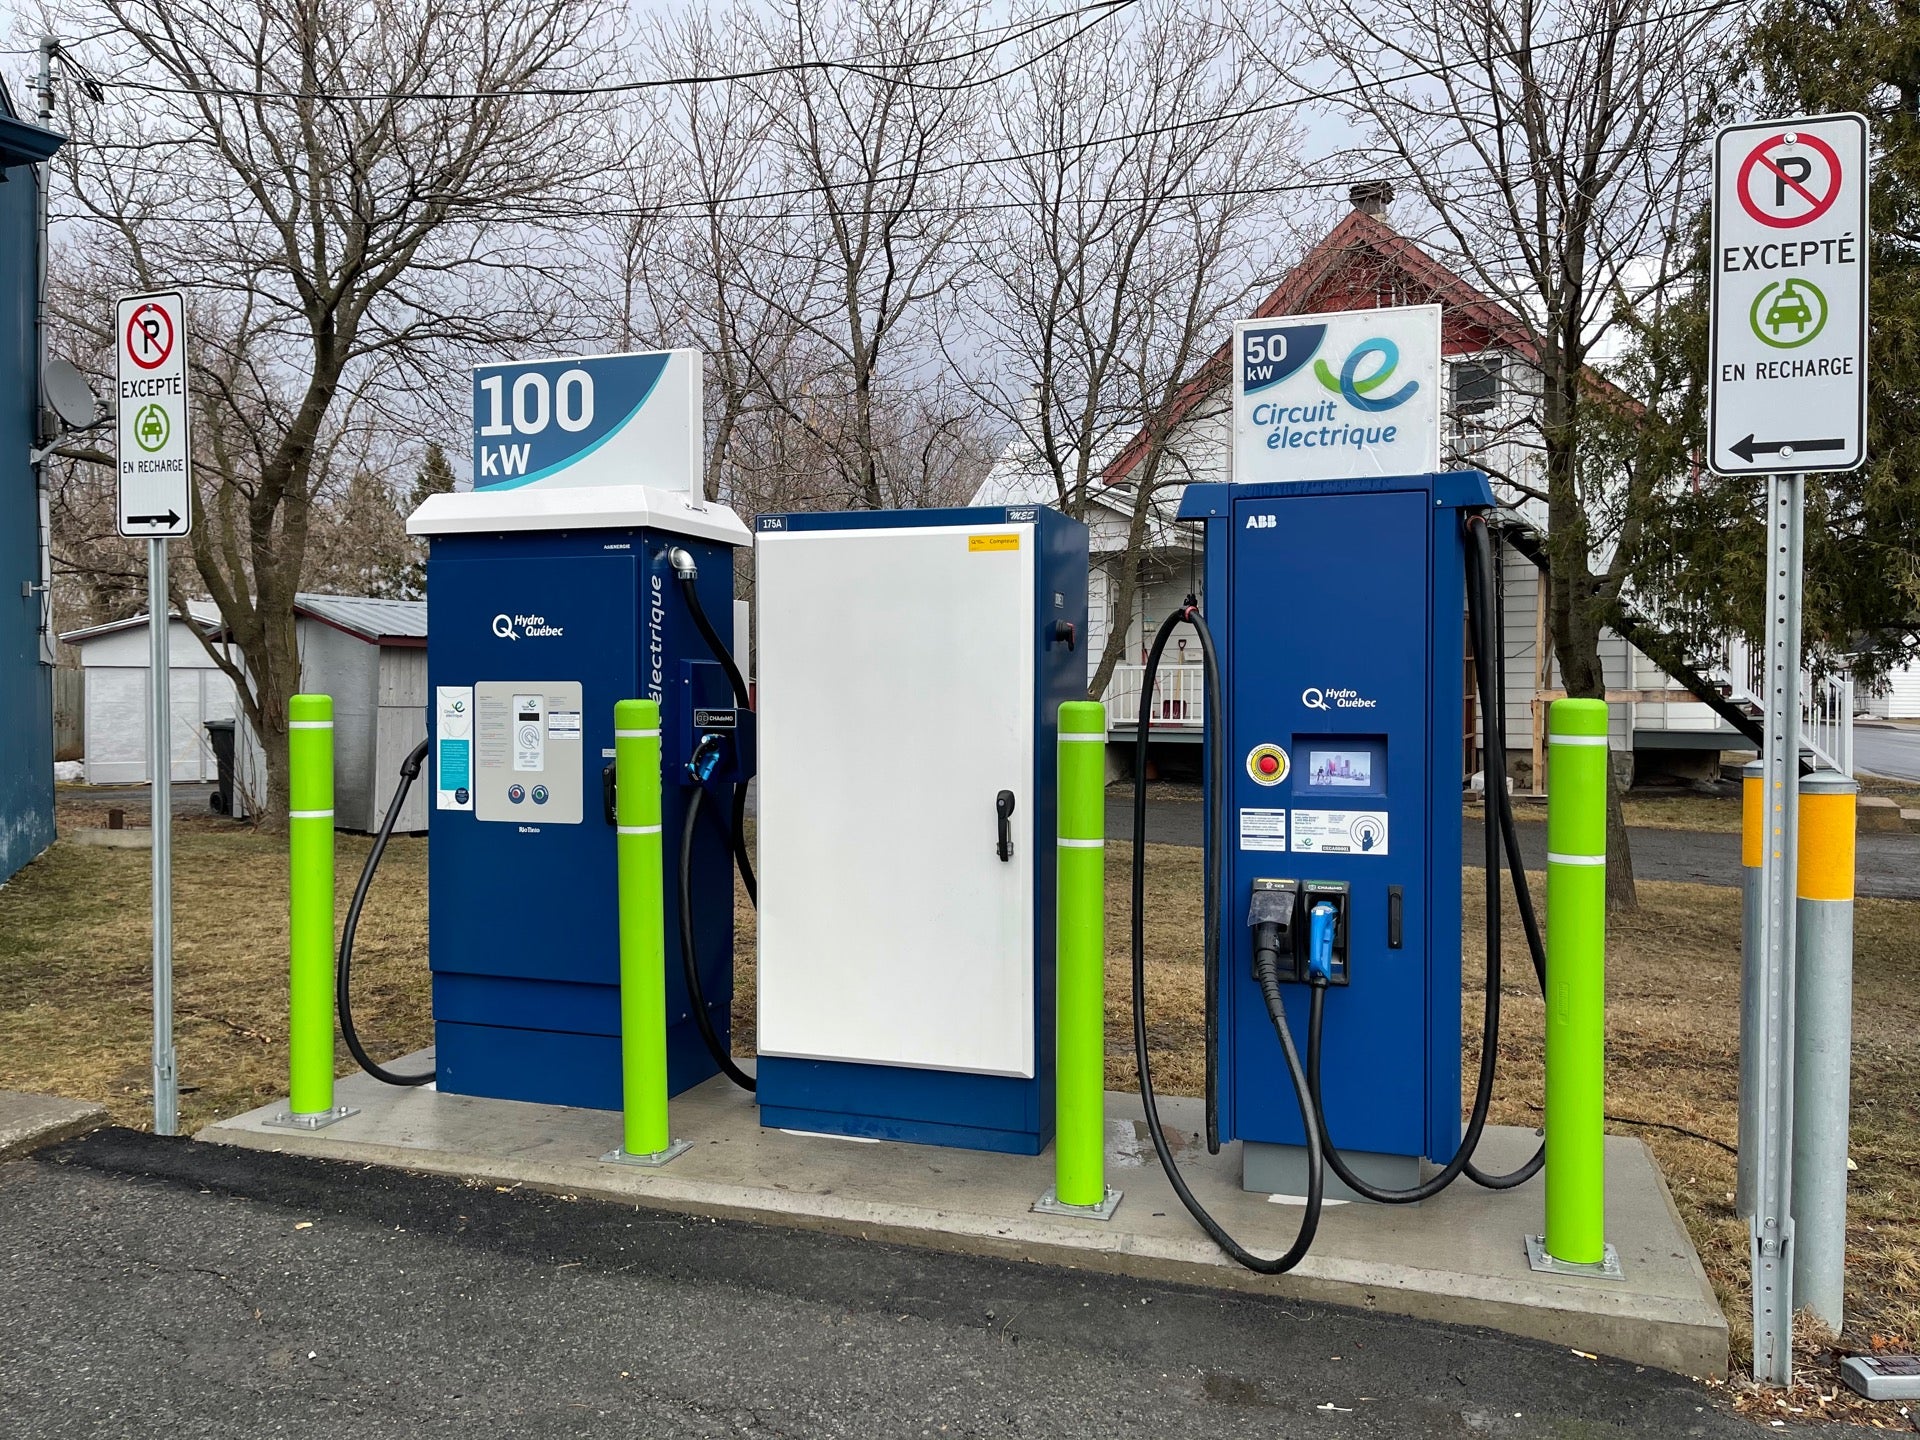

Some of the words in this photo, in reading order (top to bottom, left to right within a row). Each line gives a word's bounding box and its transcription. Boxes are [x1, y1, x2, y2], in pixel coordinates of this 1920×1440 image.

[1723, 232, 1856, 273] EXCEPTÉ
[1246, 334, 1288, 363] 50
[1247, 365, 1273, 381] kW
[1722, 363, 1746, 382] EN
[1756, 356, 1854, 380] RECHARGE
[121, 372, 182, 399] EXCEPTÉ
[480, 369, 595, 437] 100
[1252, 400, 1338, 426] Circuit
[1266, 423, 1398, 450] électrique
[123, 460, 134, 473] EN
[138, 458, 184, 473] RECHARGE
[481, 443, 531, 477] kW
[762, 518, 782, 530] 175A
[1245, 514, 1277, 529] ABB
[514, 614, 545, 627] Hydro
[525, 624, 564, 637] Québec
[1325, 688, 1357, 699] Hydro
[1337, 697, 1377, 709] Québec
